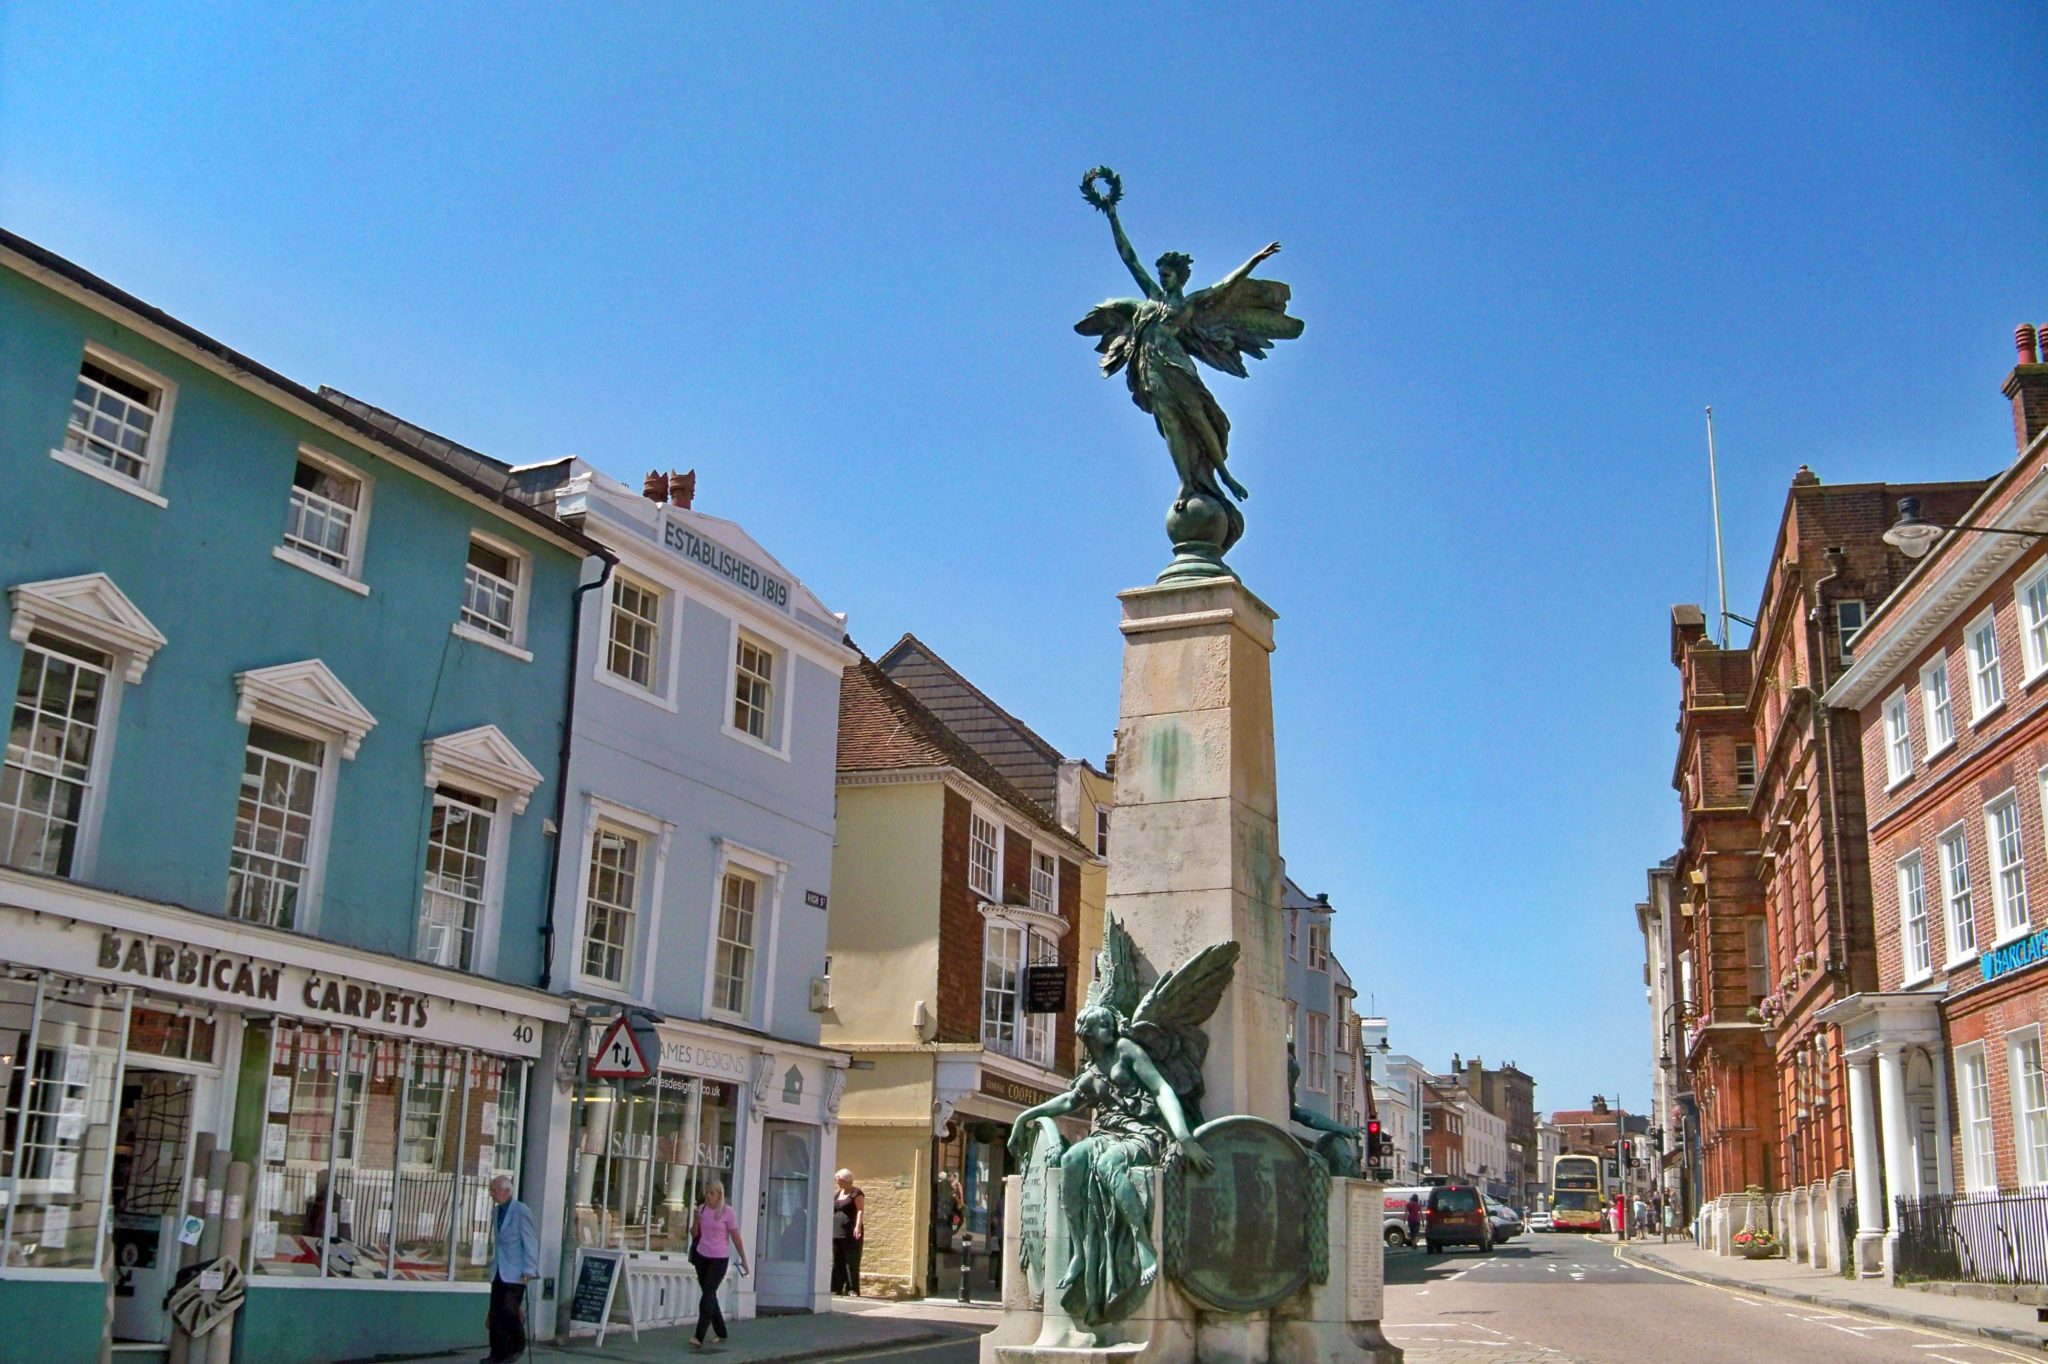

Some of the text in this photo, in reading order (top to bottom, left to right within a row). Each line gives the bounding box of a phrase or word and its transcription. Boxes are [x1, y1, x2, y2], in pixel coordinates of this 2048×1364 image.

[664, 520, 788, 607] ESTABLISHED 1819
[98, 932, 280, 1001] BARBICAN
[1993, 927, 2048, 976] BARCLAYS
[303, 975, 429, 1028] CARPETS
[512, 1024, 534, 1044] 40
[660, 1041, 745, 1074] AMES DESIGNS
[1008, 1083, 1038, 1105] COOPER
[612, 1130, 651, 1159] SALE
[696, 1142, 732, 1169] SALE
